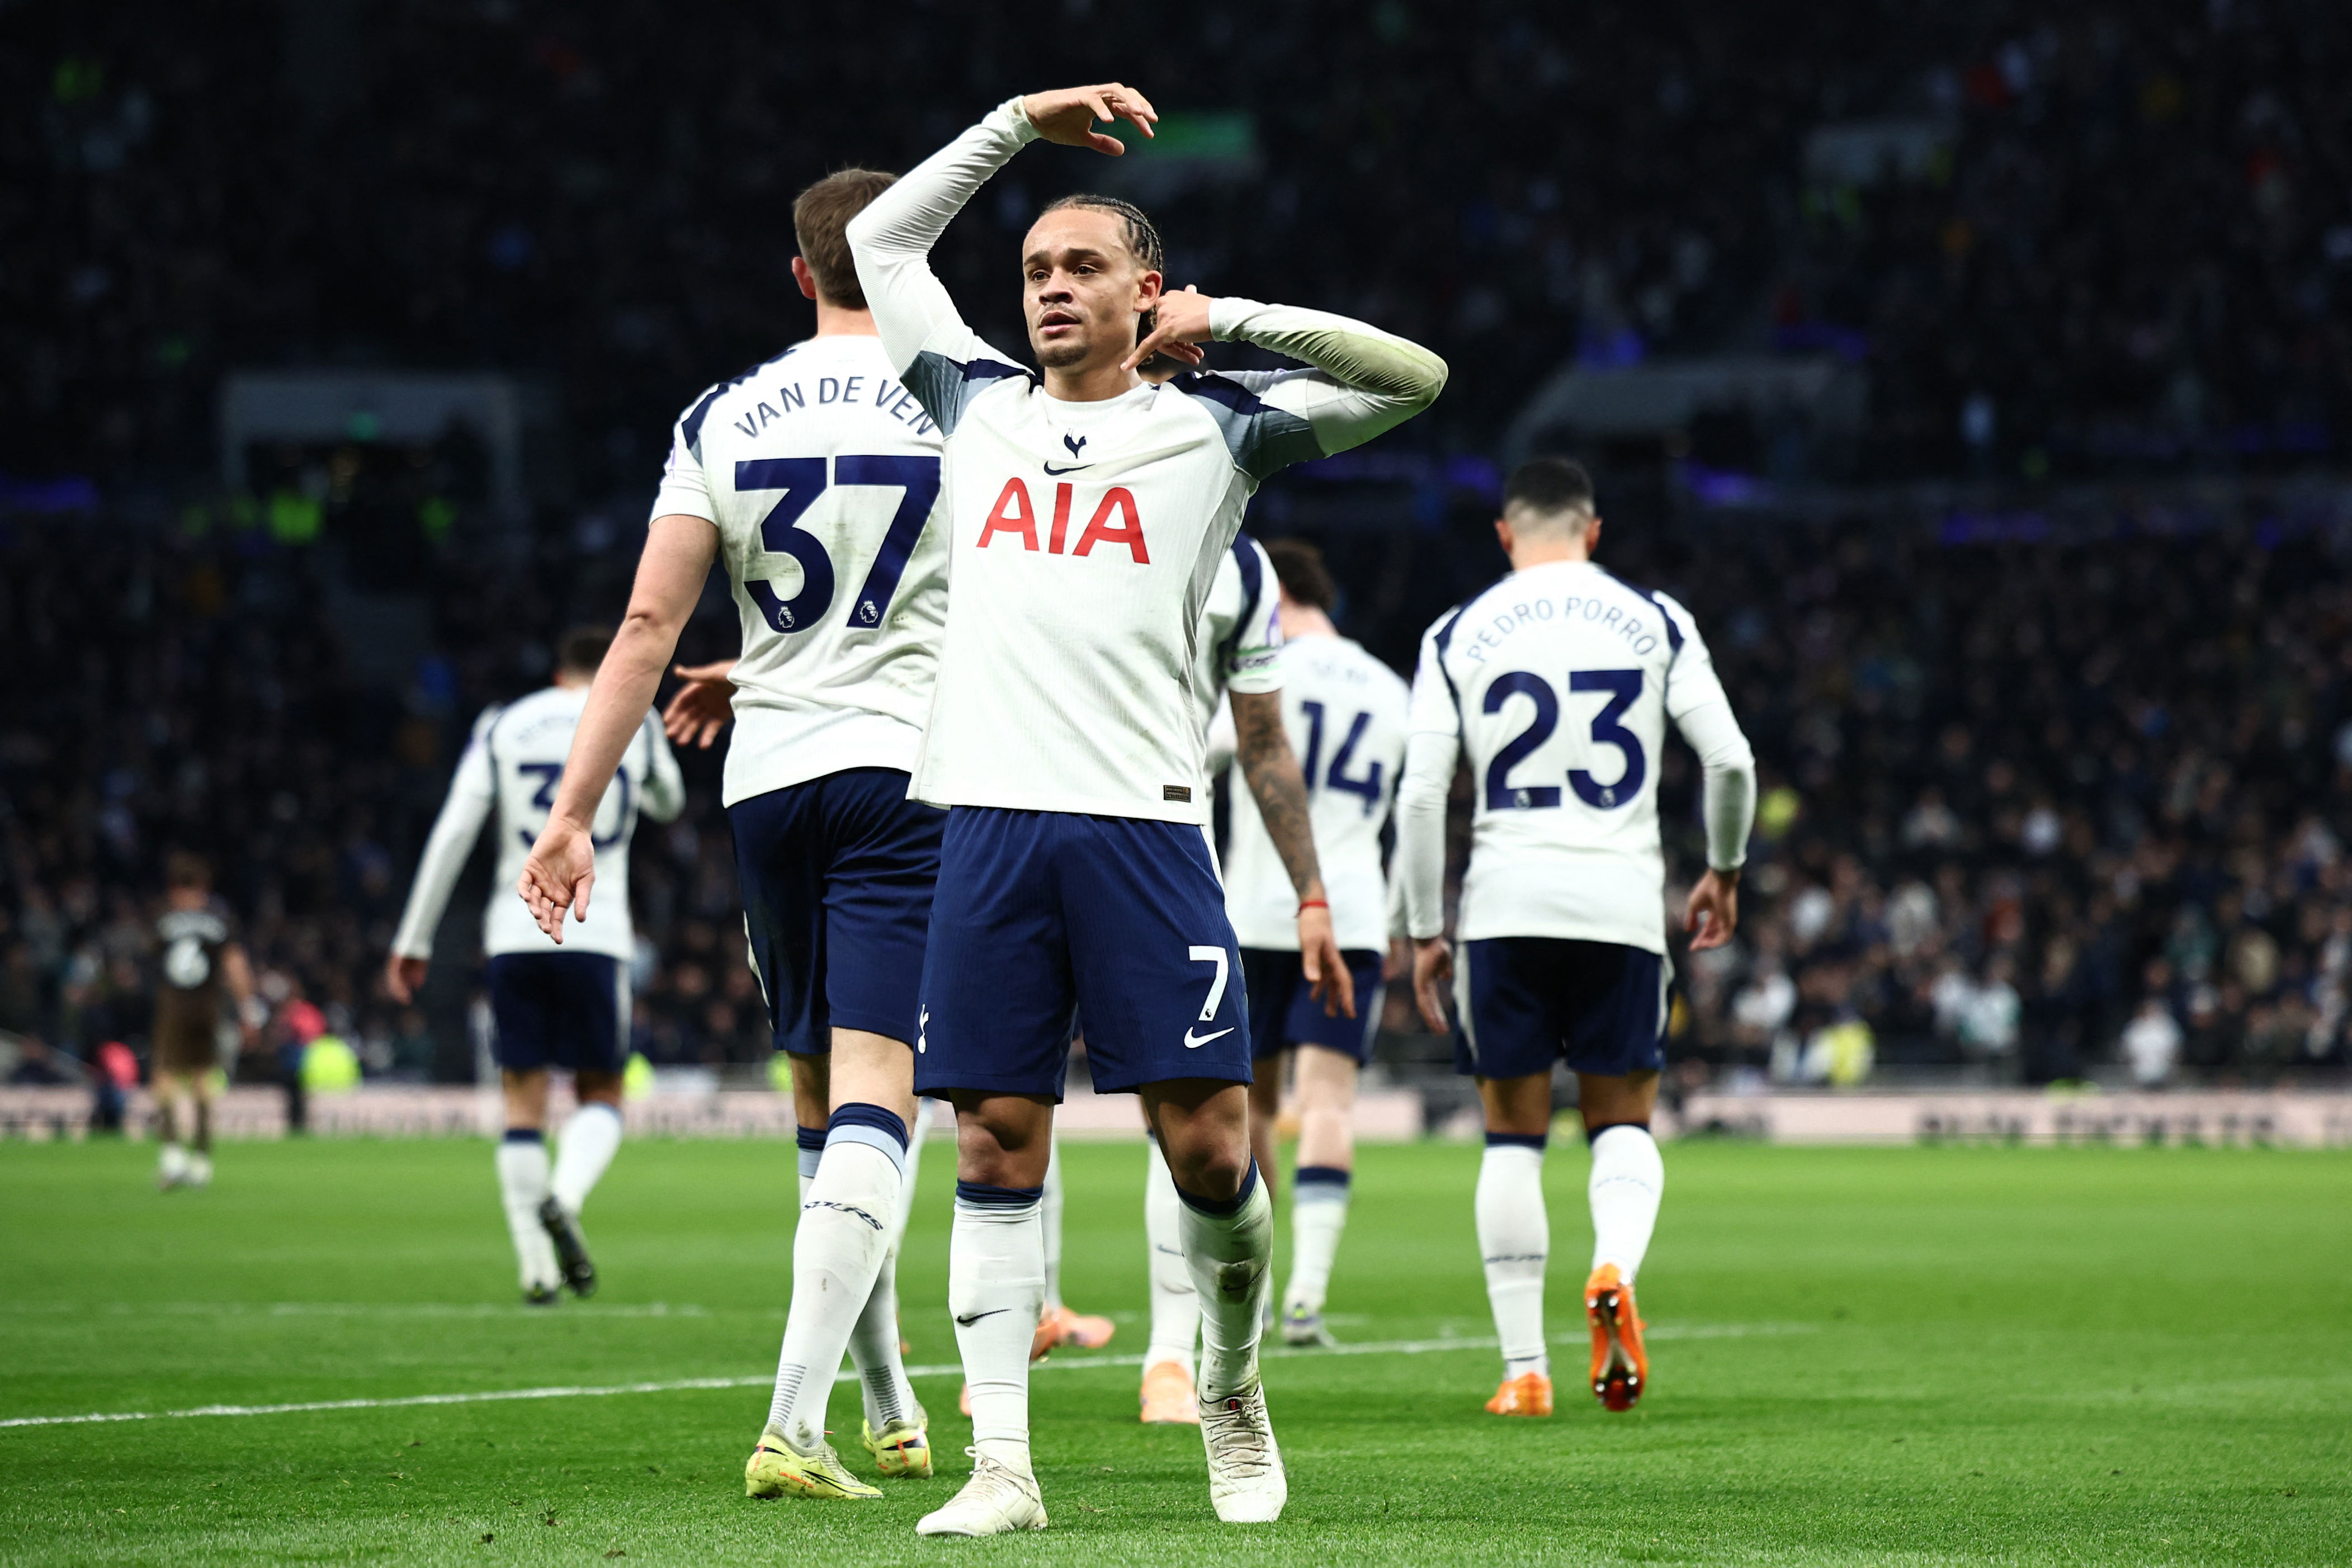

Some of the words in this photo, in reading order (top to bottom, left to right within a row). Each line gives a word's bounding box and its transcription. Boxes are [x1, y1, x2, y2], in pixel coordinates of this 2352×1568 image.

[734, 382, 806, 439] VAN
[819, 376, 865, 404] DE
[875, 379, 937, 436] VEN
[734, 455, 941, 634] 37
[976, 476, 1151, 565] AIA
[1467, 599, 1554, 663] PEDRO
[1565, 597, 1657, 656] PORRO
[1301, 700, 1383, 819] 14
[1482, 669, 1646, 812] 23
[1188, 945, 1229, 1022] 7
